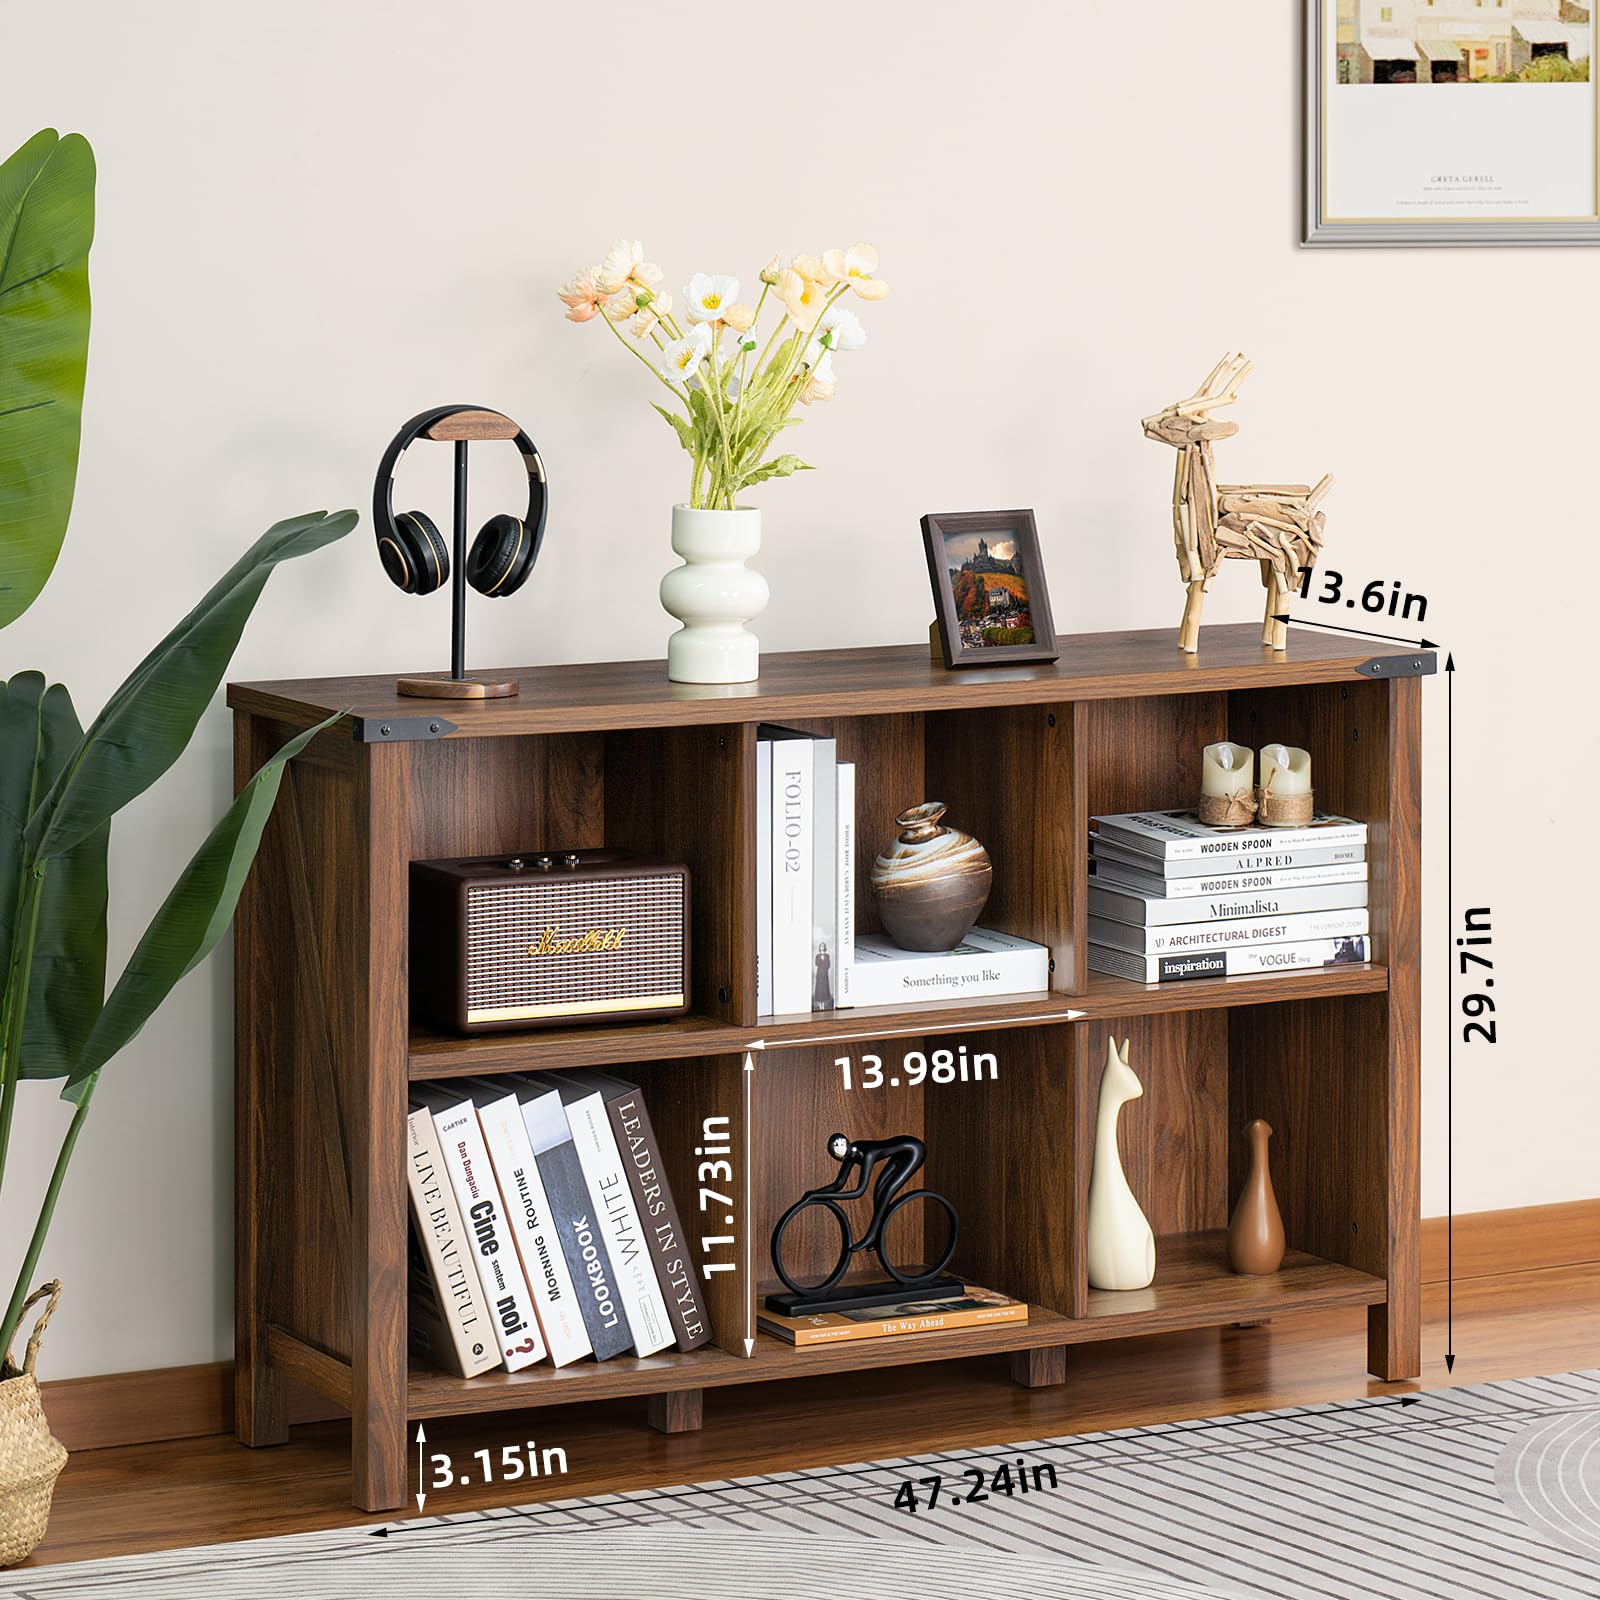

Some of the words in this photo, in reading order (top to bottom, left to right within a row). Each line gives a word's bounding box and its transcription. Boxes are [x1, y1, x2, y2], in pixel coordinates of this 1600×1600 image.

[785, 770, 802, 873] FOLIO-02
[1200, 841, 1239, 853] WOODEN
[1242, 839, 1272, 850] SPOON
[1236, 855, 1293, 869] ALPRED
[1200, 879, 1239, 891] WOODEN
[1242, 877, 1272, 888] SPOON
[1210, 900, 1279, 918] Minimalista
[1169, 930, 1250, 946] ARCHITECTURAL
[1252, 926, 1288, 939] DIGEST
[1164, 958, 1224, 976] inspiration
[1259, 952, 1296, 966] VOGUE
[902, 973, 959, 988] Something
[960, 974, 980, 987] you
[982, 970, 1001, 981] like
[442, 1117, 468, 1133] CARTIER
[457, 1141, 468, 1159] Dan
[462, 1159, 480, 1199] Dungaciu
[514, 1168, 540, 1230] ROUTINE
[599, 1173, 640, 1266] WHITE
[618, 1100, 666, 1217] LEADERS
[655, 1221, 677, 1252] IN
[666, 1258, 704, 1340] STYLE
[413, 1150, 442, 1205] LIVE
[430, 1207, 478, 1334] BEAUTIFUL
[470, 1200, 499, 1257] Cine
[496, 1295, 528, 1336] noi
[535, 1236, 561, 1302] MORNING
[572, 1215, 619, 1329] LOOKBOOK
[881, 1324, 897, 1333] The
[899, 1321, 917, 1331] Way
[919, 1317, 944, 1329] Ahead
